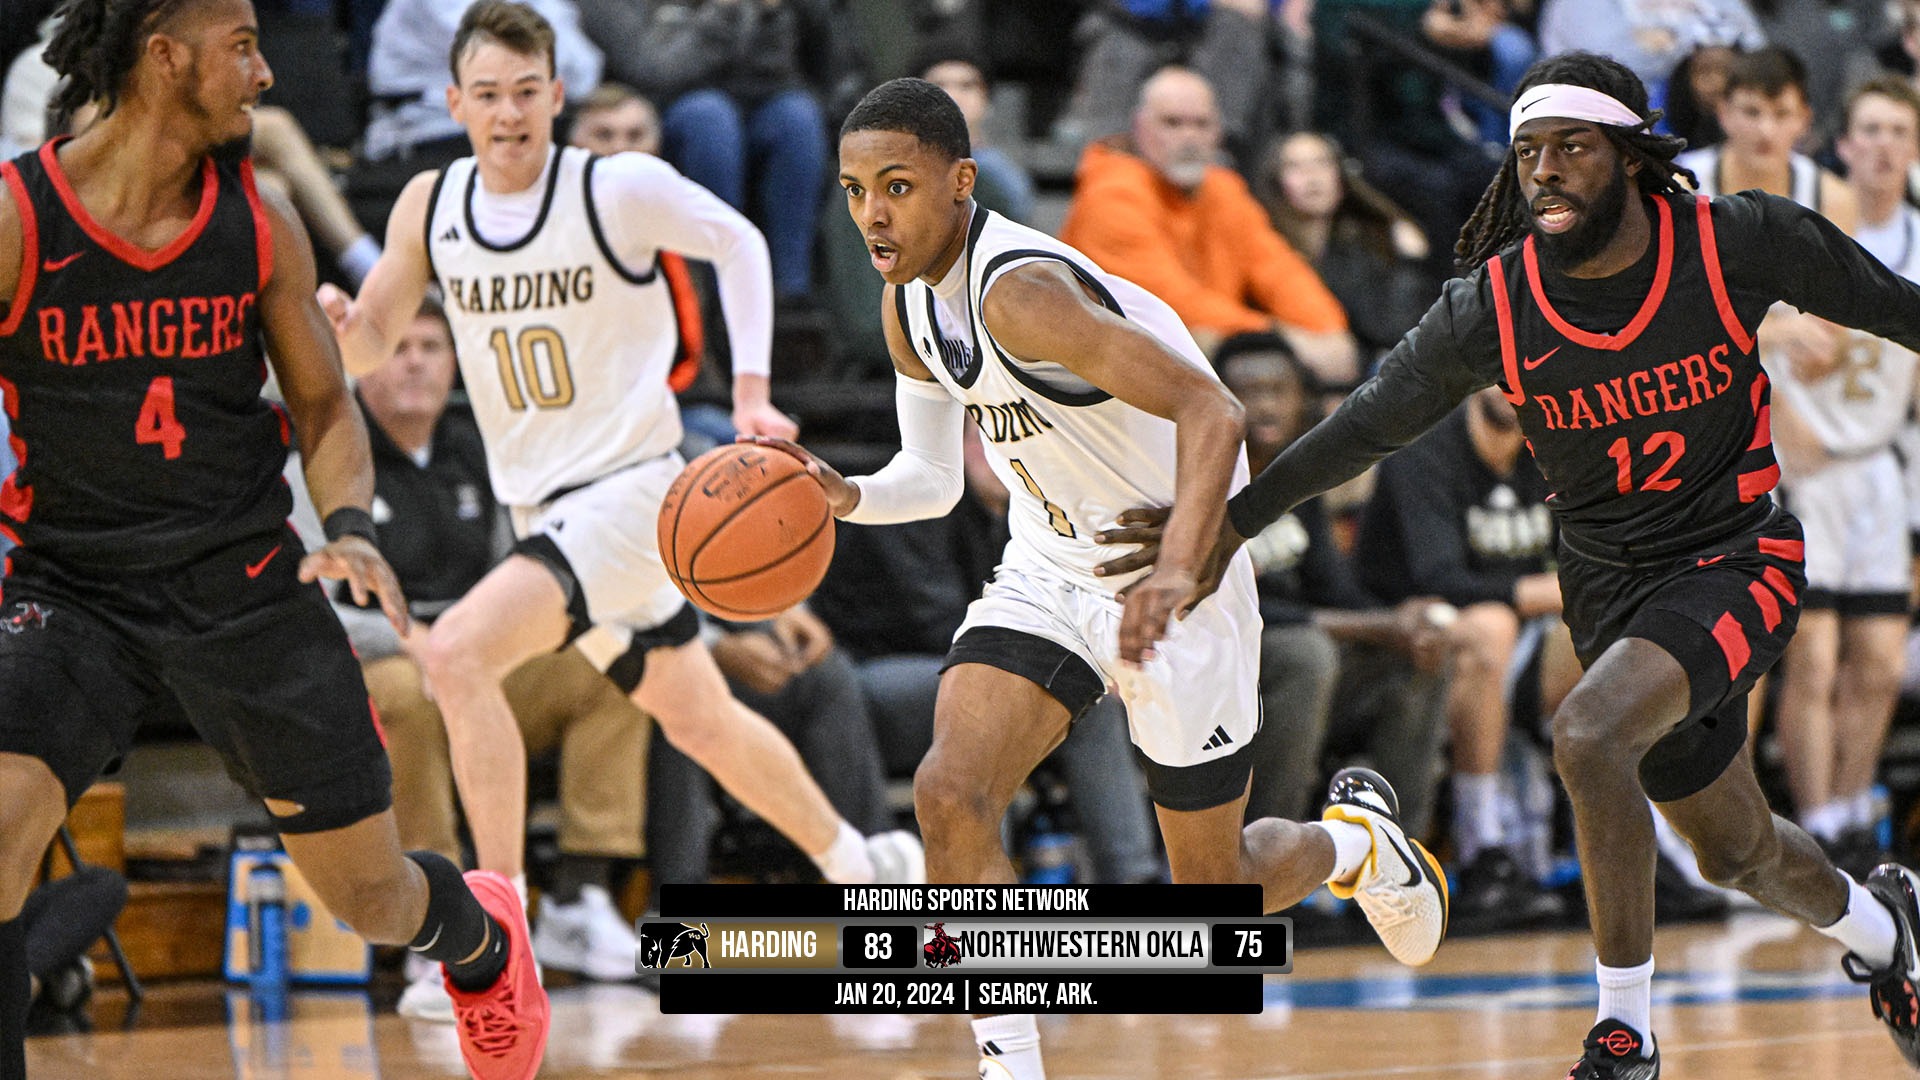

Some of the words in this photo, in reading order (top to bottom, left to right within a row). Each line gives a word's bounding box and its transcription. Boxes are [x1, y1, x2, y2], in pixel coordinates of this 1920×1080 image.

[489, 325, 575, 411] 10
[1533, 343, 1733, 430] RANGERS
[134, 375, 187, 460] 4
[1606, 430, 1686, 495] 12
